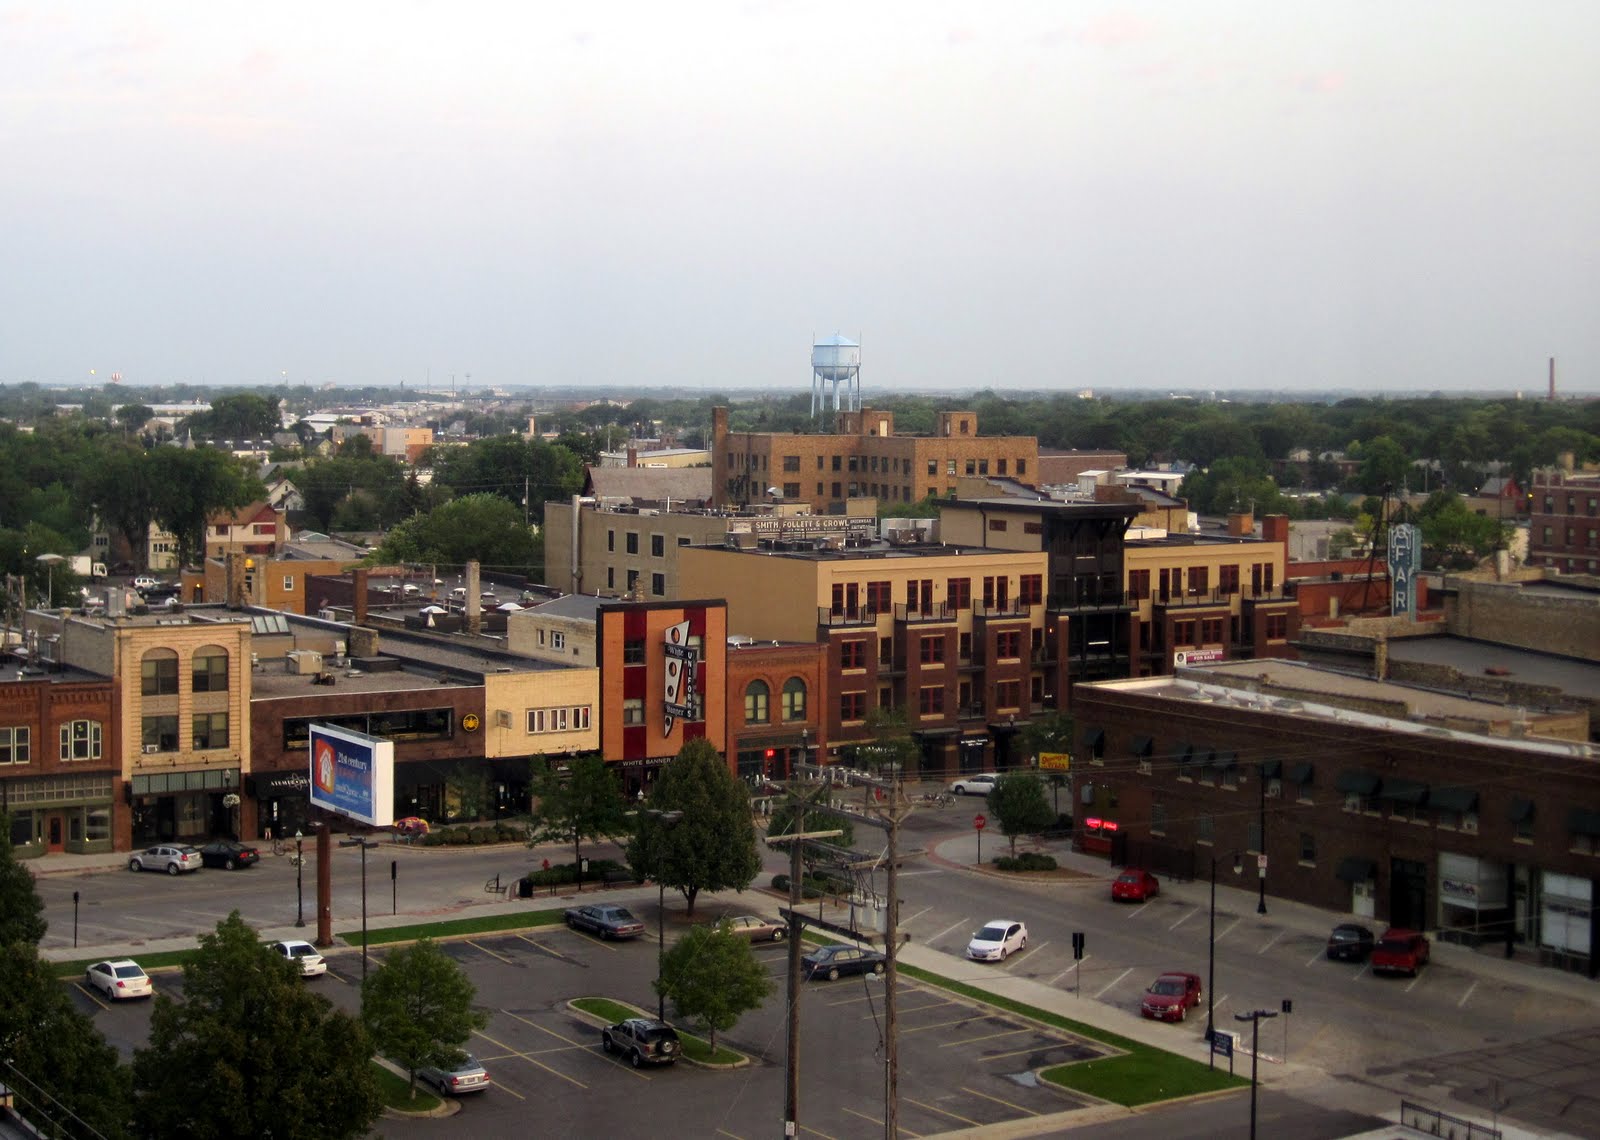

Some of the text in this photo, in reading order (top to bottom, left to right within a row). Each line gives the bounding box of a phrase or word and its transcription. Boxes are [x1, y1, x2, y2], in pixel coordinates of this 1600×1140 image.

[782, 520, 813, 528] FOLLETT
[815, 520, 821, 528] &
[823, 519, 850, 527] CROWL
[667, 645, 684, 657] White
[347, 757, 367, 774] century
[645, 757, 671, 765] BANNER
